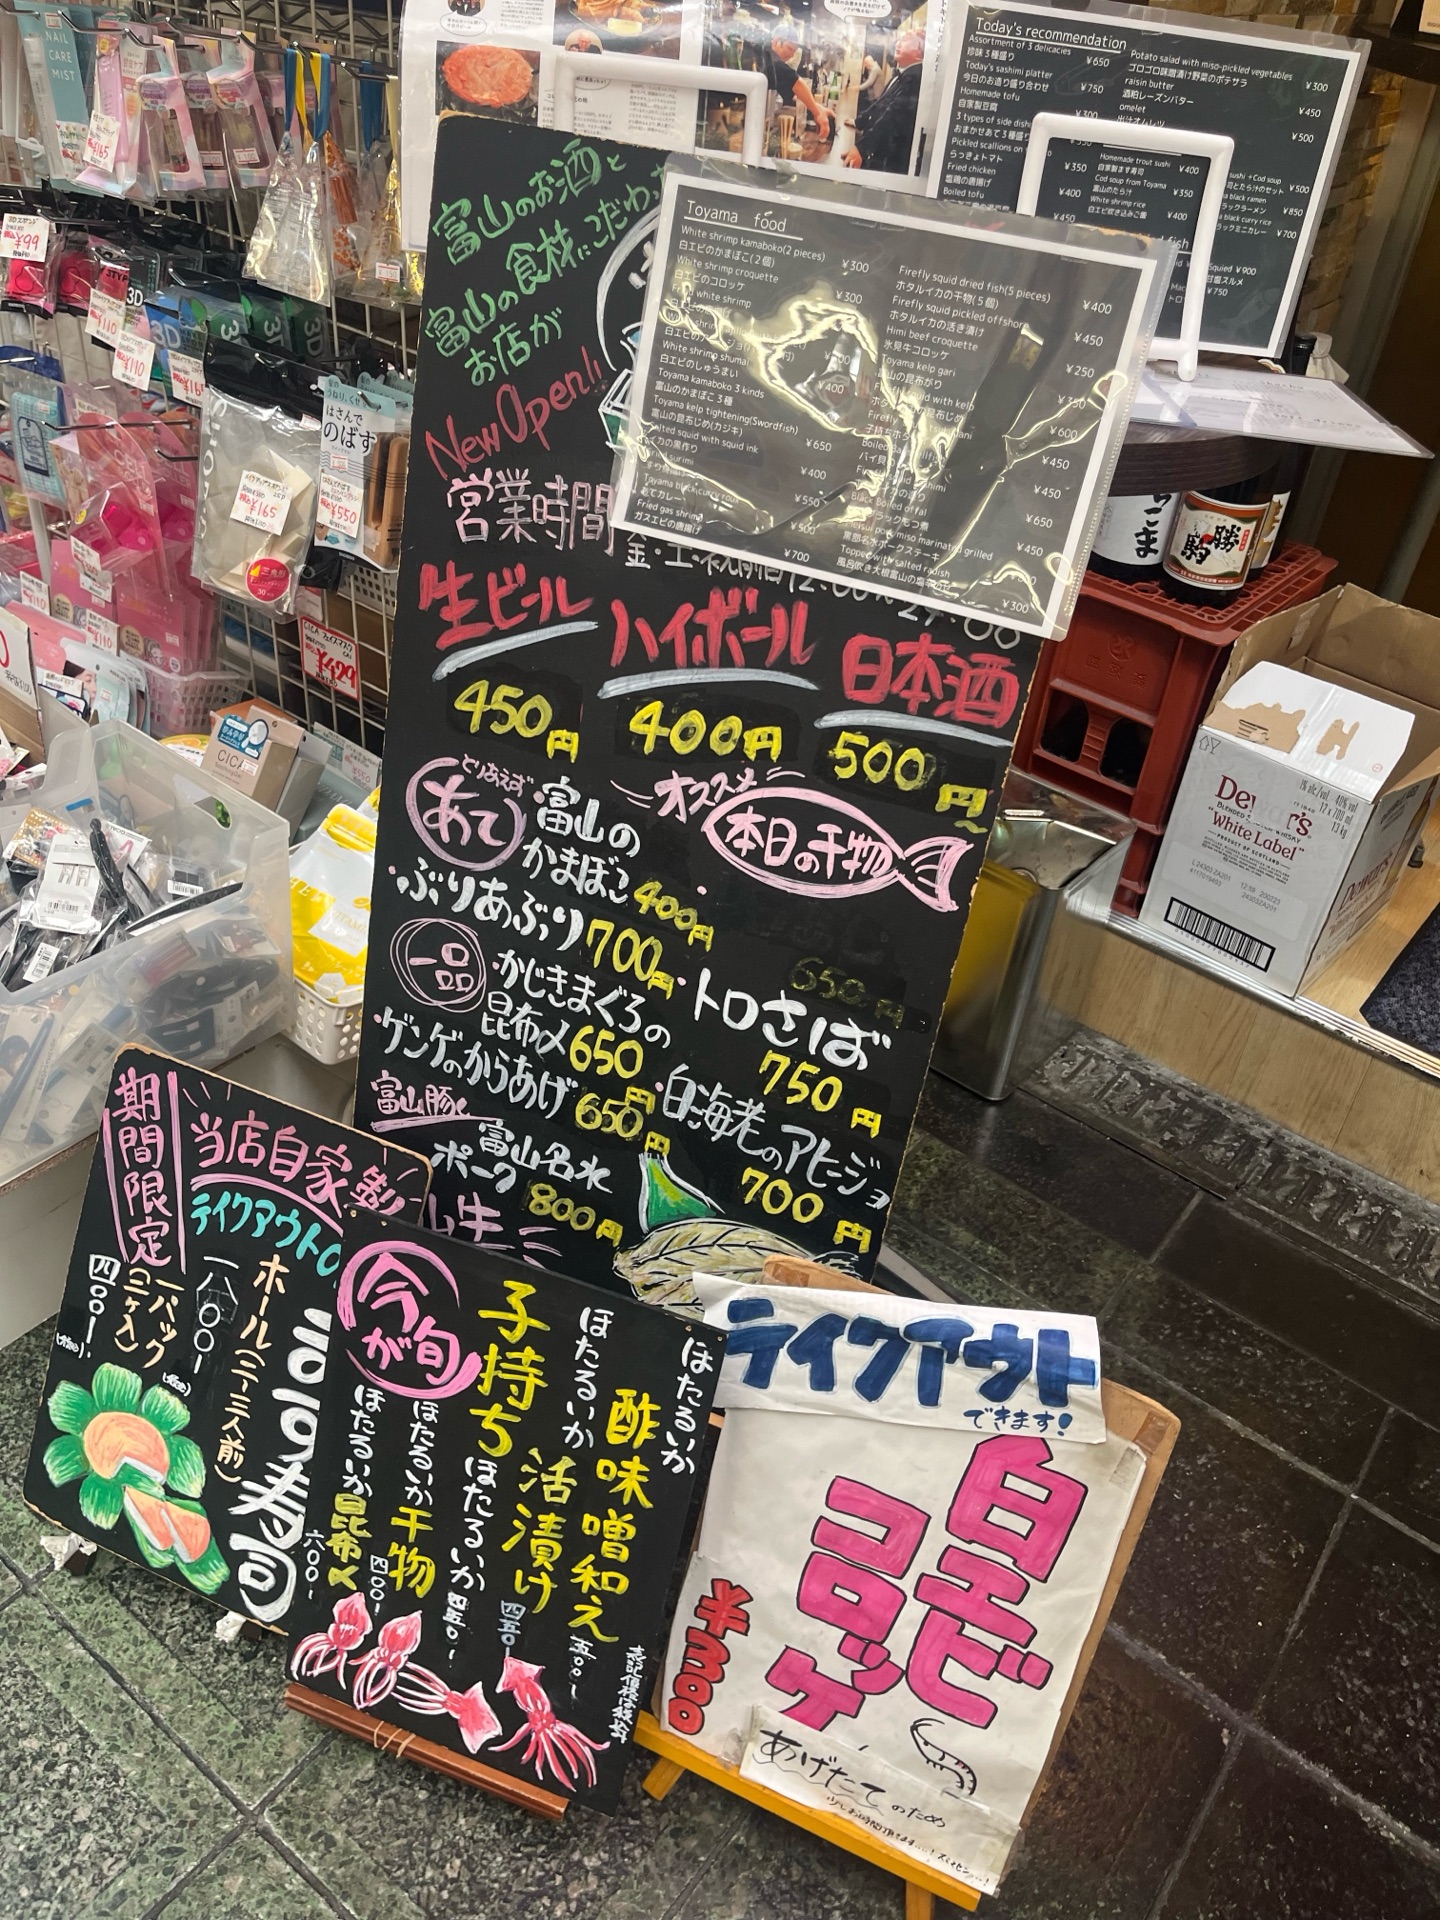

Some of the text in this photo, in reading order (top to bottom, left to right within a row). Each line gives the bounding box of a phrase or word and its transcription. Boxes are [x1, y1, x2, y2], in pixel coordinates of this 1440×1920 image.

[45, 31, 69, 45] NAIL
[968, 34, 1071, 56] Assortment of delicacies
[974, 16, 1127, 52] Today's recommendation
[49, 51, 72, 63] CARE
[995, 64, 1052, 80] sashimi platter
[1130, 50, 1292, 82] Potato salad with vegetables
[52, 68, 75, 81] MIST
[1124, 76, 1174, 91] raisin butter
[1305, 81, 1329, 92] ¥300
[960, 86, 1020, 102] Homemade tofu
[1119, 102, 1146, 113] omelet
[963, 112, 1012, 127] types of side
[1298, 107, 1321, 117] ¥450
[951, 136, 1023, 154] Pickled scallions on
[1290, 132, 1314, 143] ¥500
[947, 162, 996, 175] Fried chicken
[943, 186, 985, 199] Boiled tofu
[1142, 180, 1167, 190] Toyama
[432, 138, 626, 266] 富山のお酒と
[685, 200, 787, 233] Toyama food
[680, 225, 739, 245] White shrimp
[676, 255, 779, 284] White shrimp croquette
[841, 259, 869, 272] ¥300
[898, 266, 984, 291] Firefly squid dried
[126, 287, 144, 307] 3D
[696, 289, 752, 308] white shrimp
[835, 290, 862, 304] ¥300
[891, 295, 985, 322] Firefly squid pickled
[1082, 300, 1112, 314] ¥400
[150, 320, 181, 348] 3D
[465, 307, 562, 386] お店が
[886, 325, 907, 338] Himi
[908, 330, 930, 342] beef
[931, 334, 978, 352] croquette
[1073, 332, 1103, 347] ¥450
[662, 341, 718, 360] White shrimp
[880, 354, 956, 378] Toyama kelp gari
[657, 368, 765, 398] Toyama kamaboko 3 kinds
[1065, 364, 1095, 378] ¥250
[326, 404, 363, 427] はさんで
[652, 395, 703, 414] Toyama kelp
[932, 395, 975, 412] with kelp
[322, 422, 377, 453] のばす
[426, 415, 500, 480] New
[676, 428, 759, 454] squid with squid ink
[805, 438, 832, 452] ¥650
[799, 466, 827, 480] ¥400
[1040, 455, 1070, 470] ¥450
[636, 499, 673, 515] Fried gas
[1033, 485, 1061, 499] ¥450
[447, 467, 615, 556] 営業時間
[964, 547, 993, 561] grilled
[418, 560, 595, 650] 生ビール
[611, 587, 819, 668] ハイボール
[842, 633, 1019, 727] 日本酒
[454, 679, 580, 763] 450円
[629, 701, 782, 762] 400円
[461, 753, 533, 797] とりあえず
[831, 731, 987, 817] 500円
[422, 774, 507, 847] あて
[654, 767, 757, 823] オススメ
[1217, 801, 1246, 820] BLENDED
[536, 775, 641, 857] 富山の
[725, 806, 893, 880] 本日の干物
[1217, 834, 1280, 866] PRODUCT SCOTLAND
[522, 837, 629, 904] かまぼこ
[397, 856, 584, 951] ぶりあぶり
[634, 880, 714, 952] 400円
[409, 942, 475, 993] 一品
[586, 919, 674, 1000] 700円
[498, 949, 671, 1049] かじきまぐろの
[694, 967, 893, 1070] トロさば
[382, 1006, 578, 1119] ゲンゲのからあげ
[758, 1050, 882, 1139] 750円
[112, 1066, 173, 1266] 期間限定
[190, 1110, 405, 1218] 当店自家製
[431, 1140, 516, 1193] ポーク
[528, 1182, 623, 1247] 800円
[741, 1167, 872, 1253] 700円
[357, 1251, 460, 1386] 今が旬
[469, 1280, 550, 1457] 子持ち
[726, 1298, 1098, 1408] テイクアウト
[562, 1307, 614, 1448] ほたるいか
[661, 1337, 713, 1474] ほたるいか
[964, 1407, 1074, 1436] できます!
[342, 1383, 386, 1499] ほたるいか
[405, 1400, 440, 1507] ほたるいか
[450, 1456, 498, 1592] ほたるいか
[502, 1447, 577, 1613] 活漬け
[568, 1388, 661, 1642] 酢味噌和え
[388, 1506, 436, 1599] 干物
[906, 1434, 1088, 1729] 白エビ
[765, 1475, 931, 1732] コロッケ
[760, 1729, 886, 1808] あげたて
[891, 1805, 946, 1828] のため
